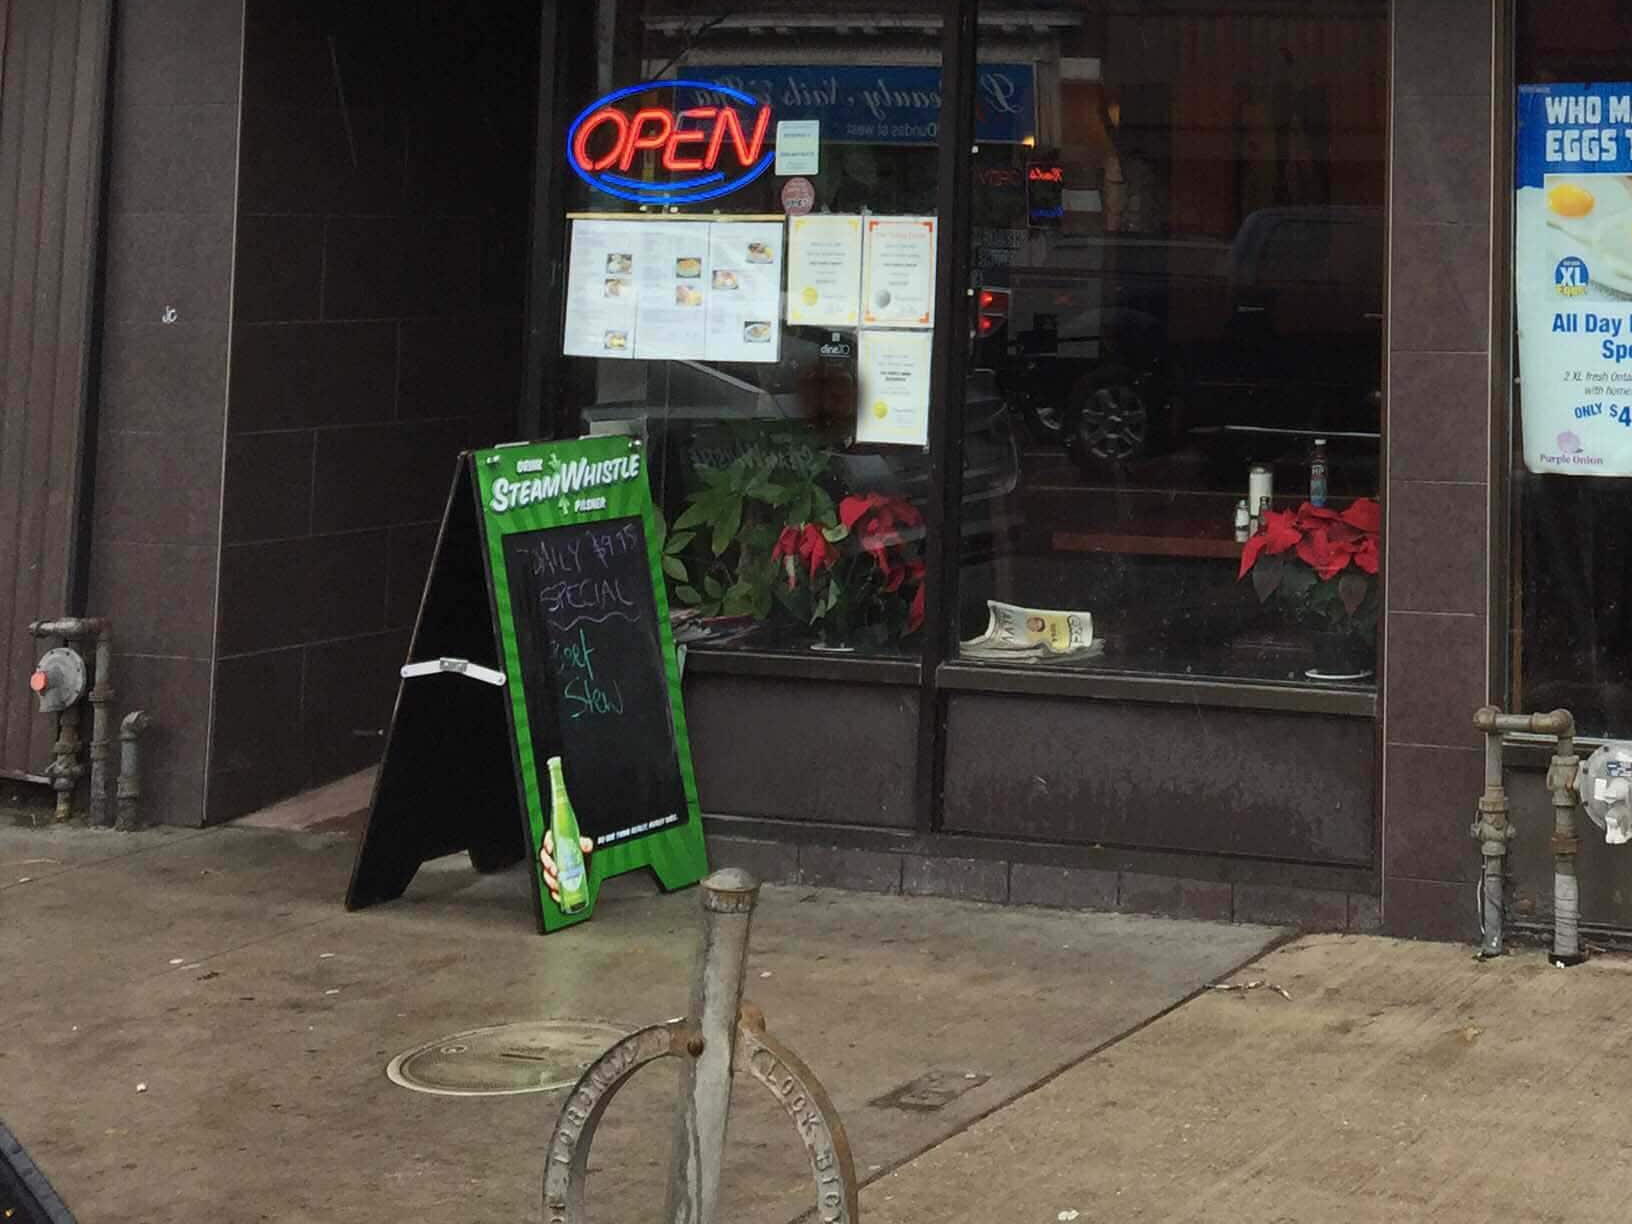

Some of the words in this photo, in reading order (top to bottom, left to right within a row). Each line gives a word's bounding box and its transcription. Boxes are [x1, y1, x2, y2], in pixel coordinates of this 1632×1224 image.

[1545, 95, 1601, 124] WHO
[573, 103, 771, 172] OPEN
[1545, 128, 1617, 162] EGGS
[1559, 266, 1587, 288] XL
[1551, 313, 1578, 333] All
[1585, 313, 1623, 338] Day
[1574, 402, 1604, 420] ONLY
[1539, 453, 1571, 466] Purple
[1572, 454, 1604, 465] Onion
[539, 576, 634, 612] SPECIAL
